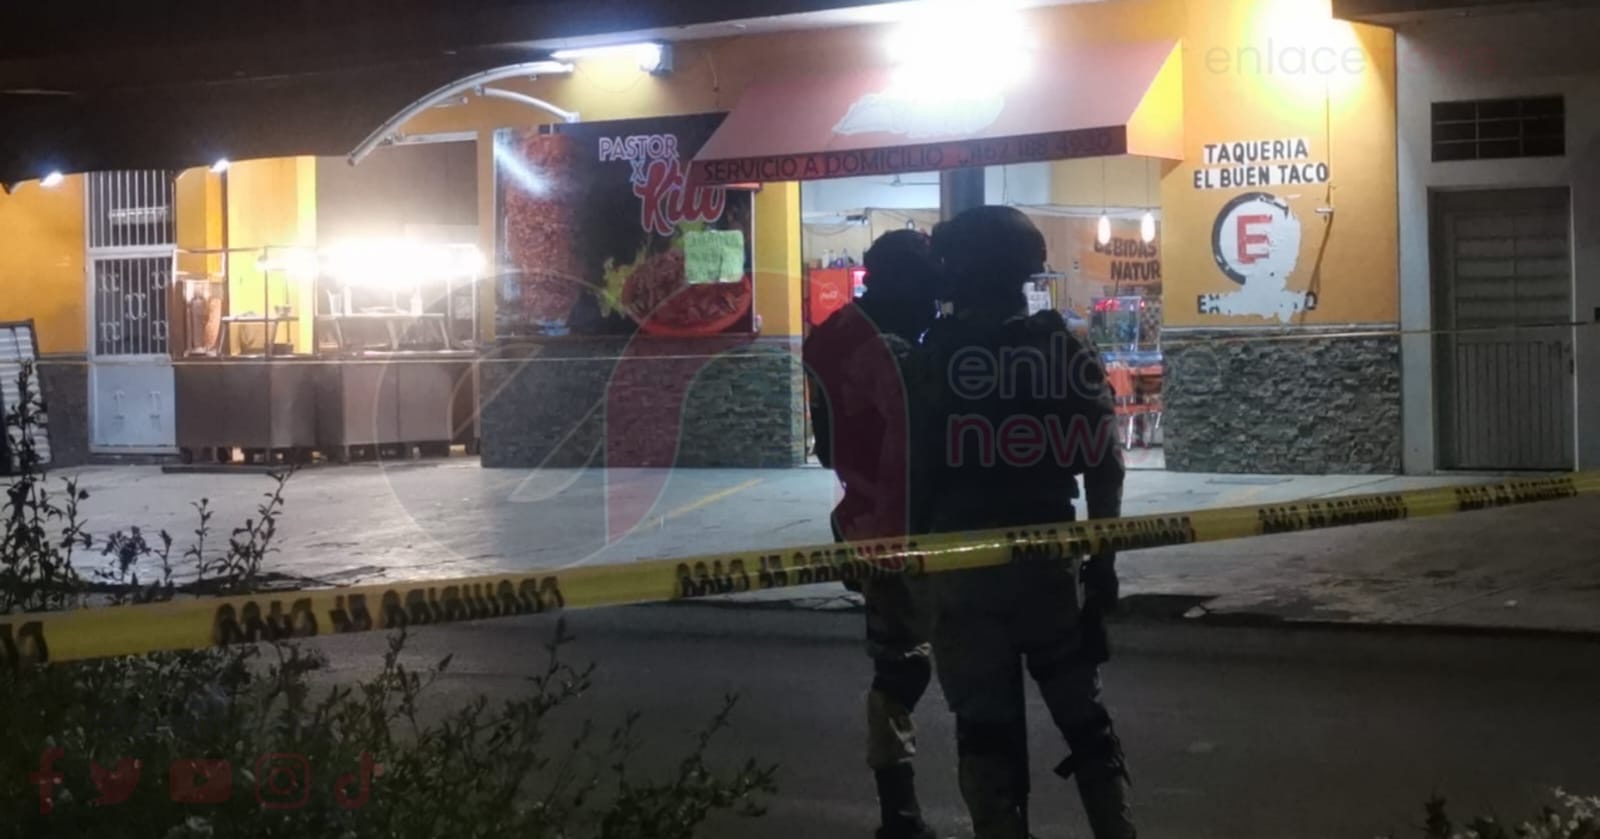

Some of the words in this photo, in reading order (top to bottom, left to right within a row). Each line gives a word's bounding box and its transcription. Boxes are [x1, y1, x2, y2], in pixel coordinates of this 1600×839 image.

[599, 134, 680, 161] PASTOR
[1204, 139, 1308, 164] TAQUERIA
[703, 158, 798, 181] SERVICIO
[803, 157, 819, 177] A
[825, 150, 944, 175] DOMICILIO
[1193, 170, 1214, 189] EL
[1220, 166, 1270, 188] BUEN
[1278, 163, 1330, 184] TACO
[1237, 214, 1272, 265] E
